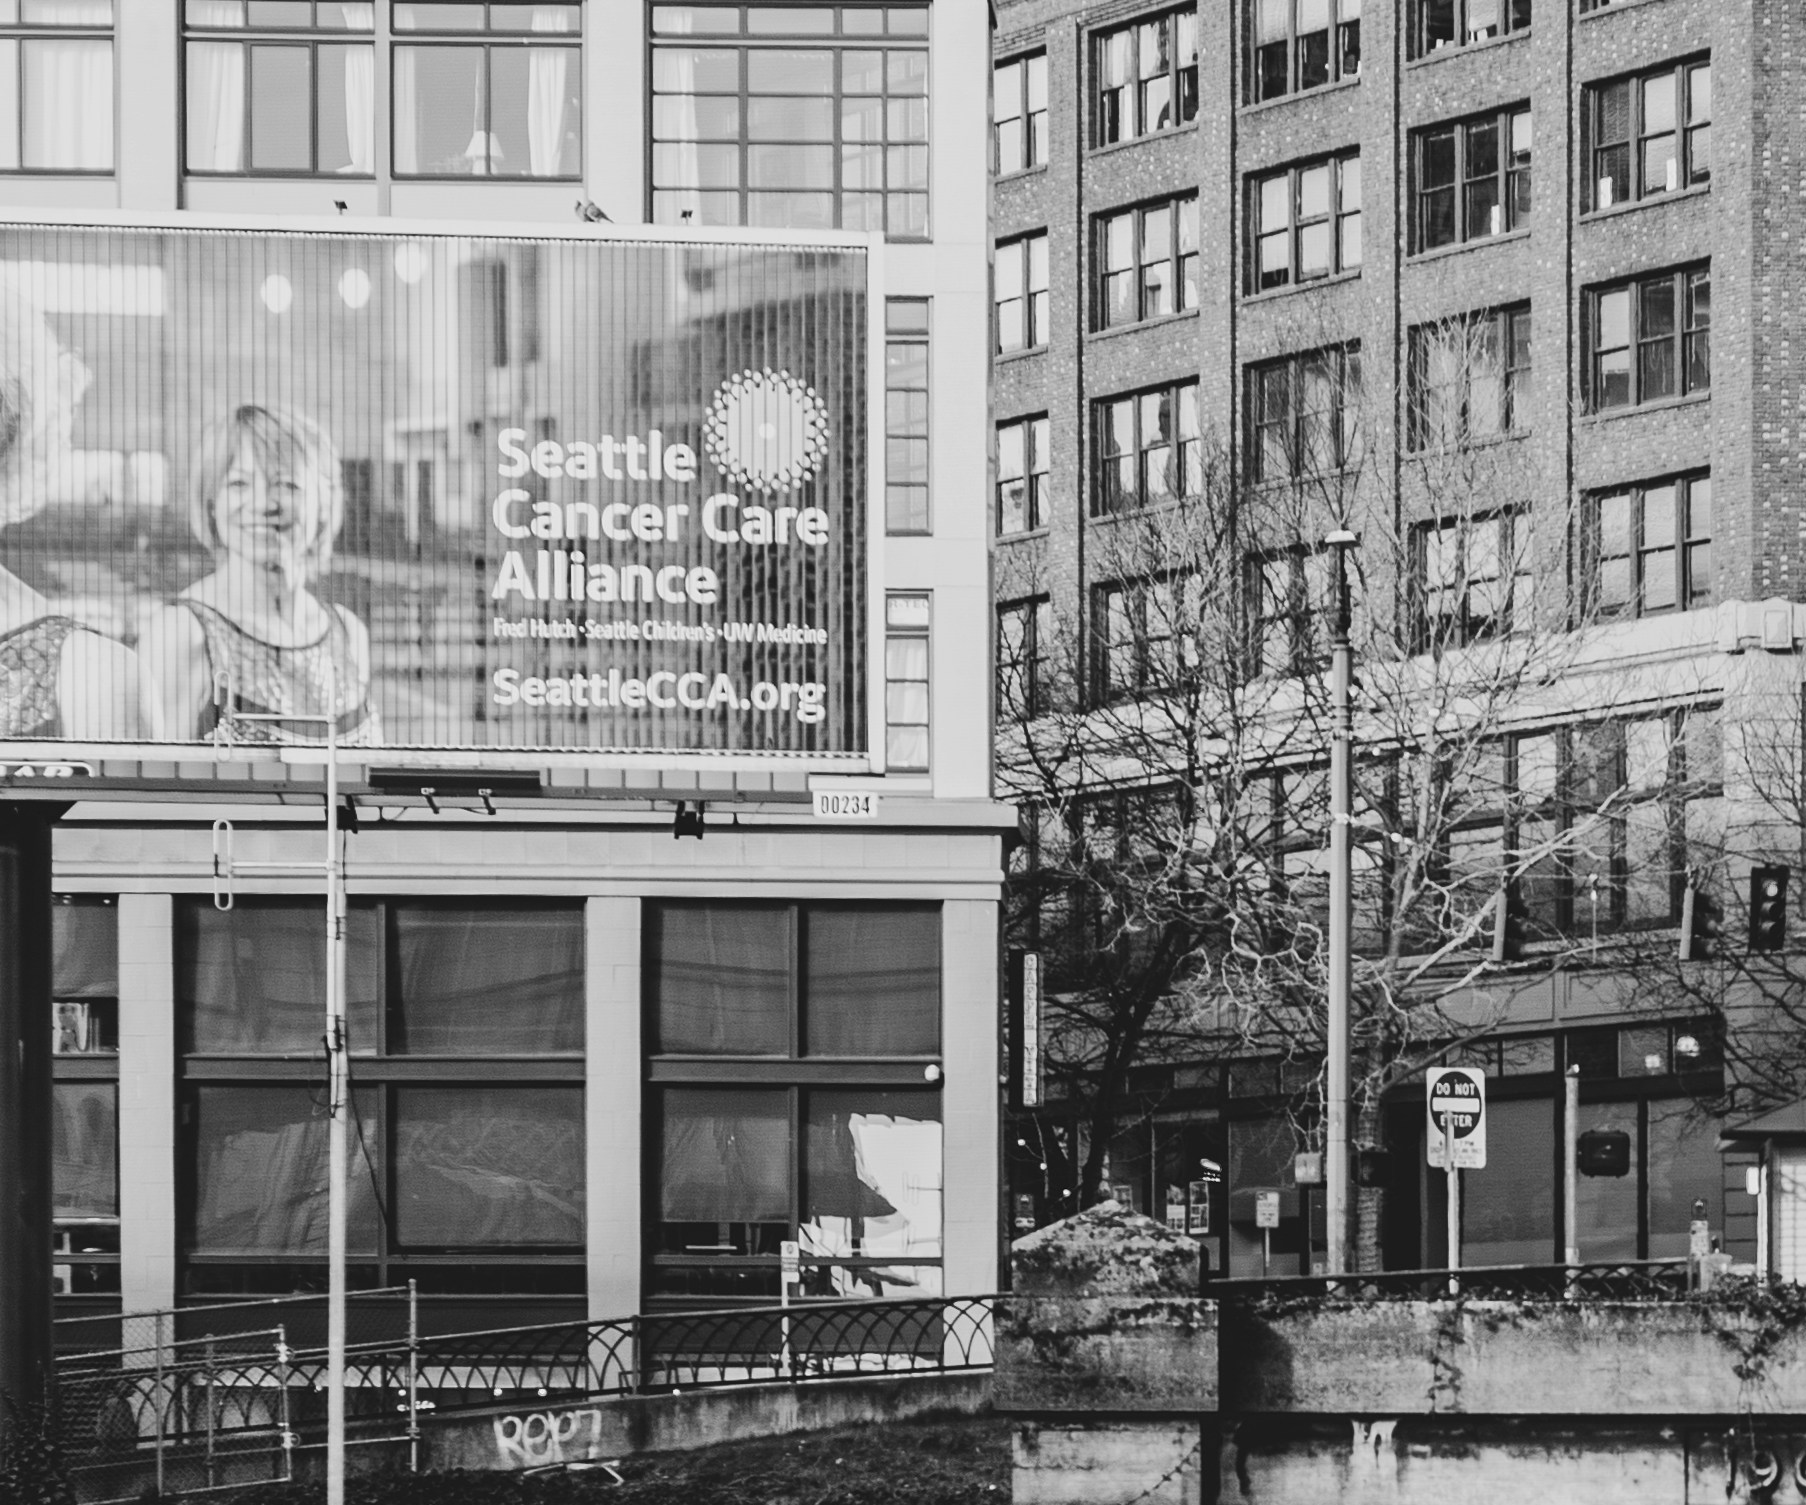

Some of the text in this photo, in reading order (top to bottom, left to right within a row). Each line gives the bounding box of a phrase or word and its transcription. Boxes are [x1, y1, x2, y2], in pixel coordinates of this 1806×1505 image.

[498, 428, 696, 482] Seattle
[493, 488, 829, 545] Cancer Care
[491, 549, 718, 605] Alliance
[494, 617, 828, 645] Fred Hutch Seattle Children's UW Medicine
[493, 667, 826, 724] SeattleCCA.org
[1436, 1082, 1475, 1096] DO NOT
[1440, 1114, 1473, 1128] ETER
